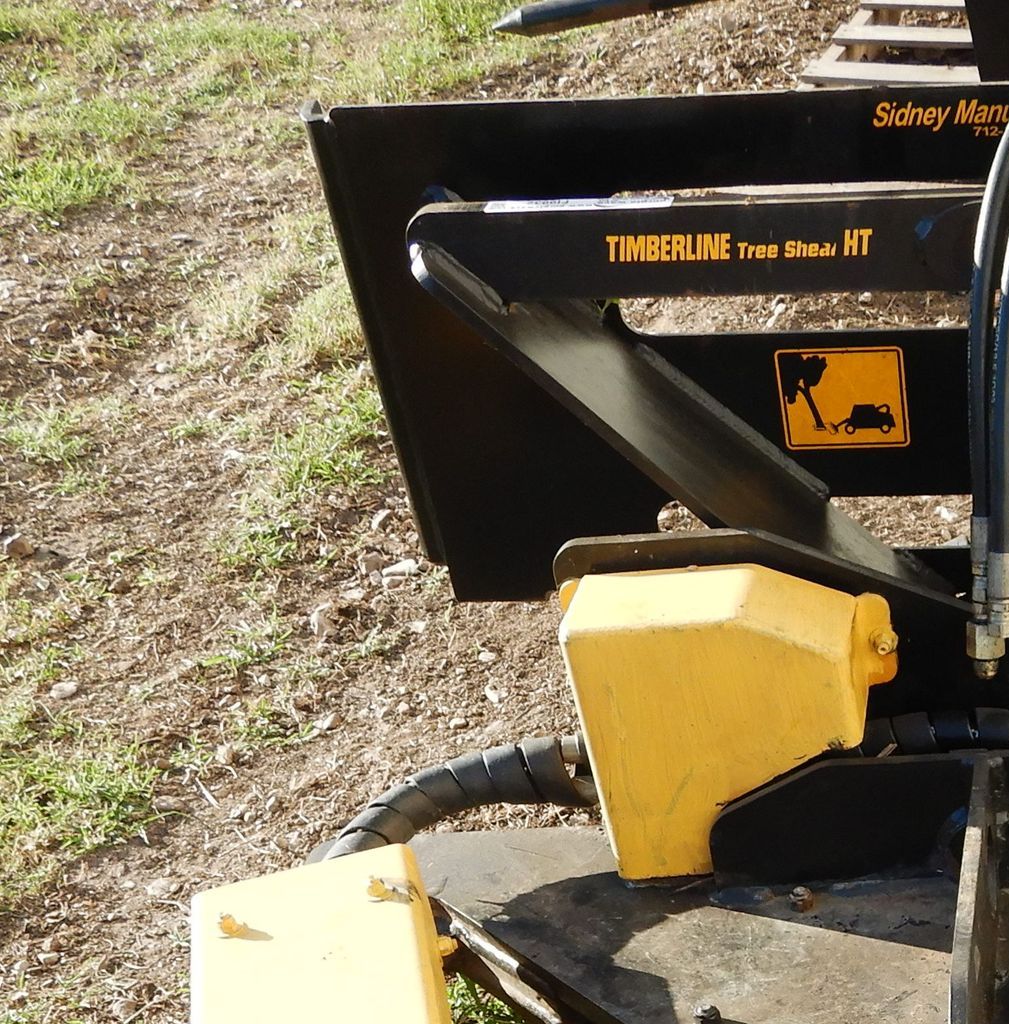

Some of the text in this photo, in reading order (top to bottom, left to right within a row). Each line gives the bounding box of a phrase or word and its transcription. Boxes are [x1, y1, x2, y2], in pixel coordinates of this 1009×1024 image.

[873, 101, 951, 131] Sidney
[606, 233, 731, 263] TIMBERLINE
[738, 242, 779, 260] Tree
[843, 228, 873, 257] HT
